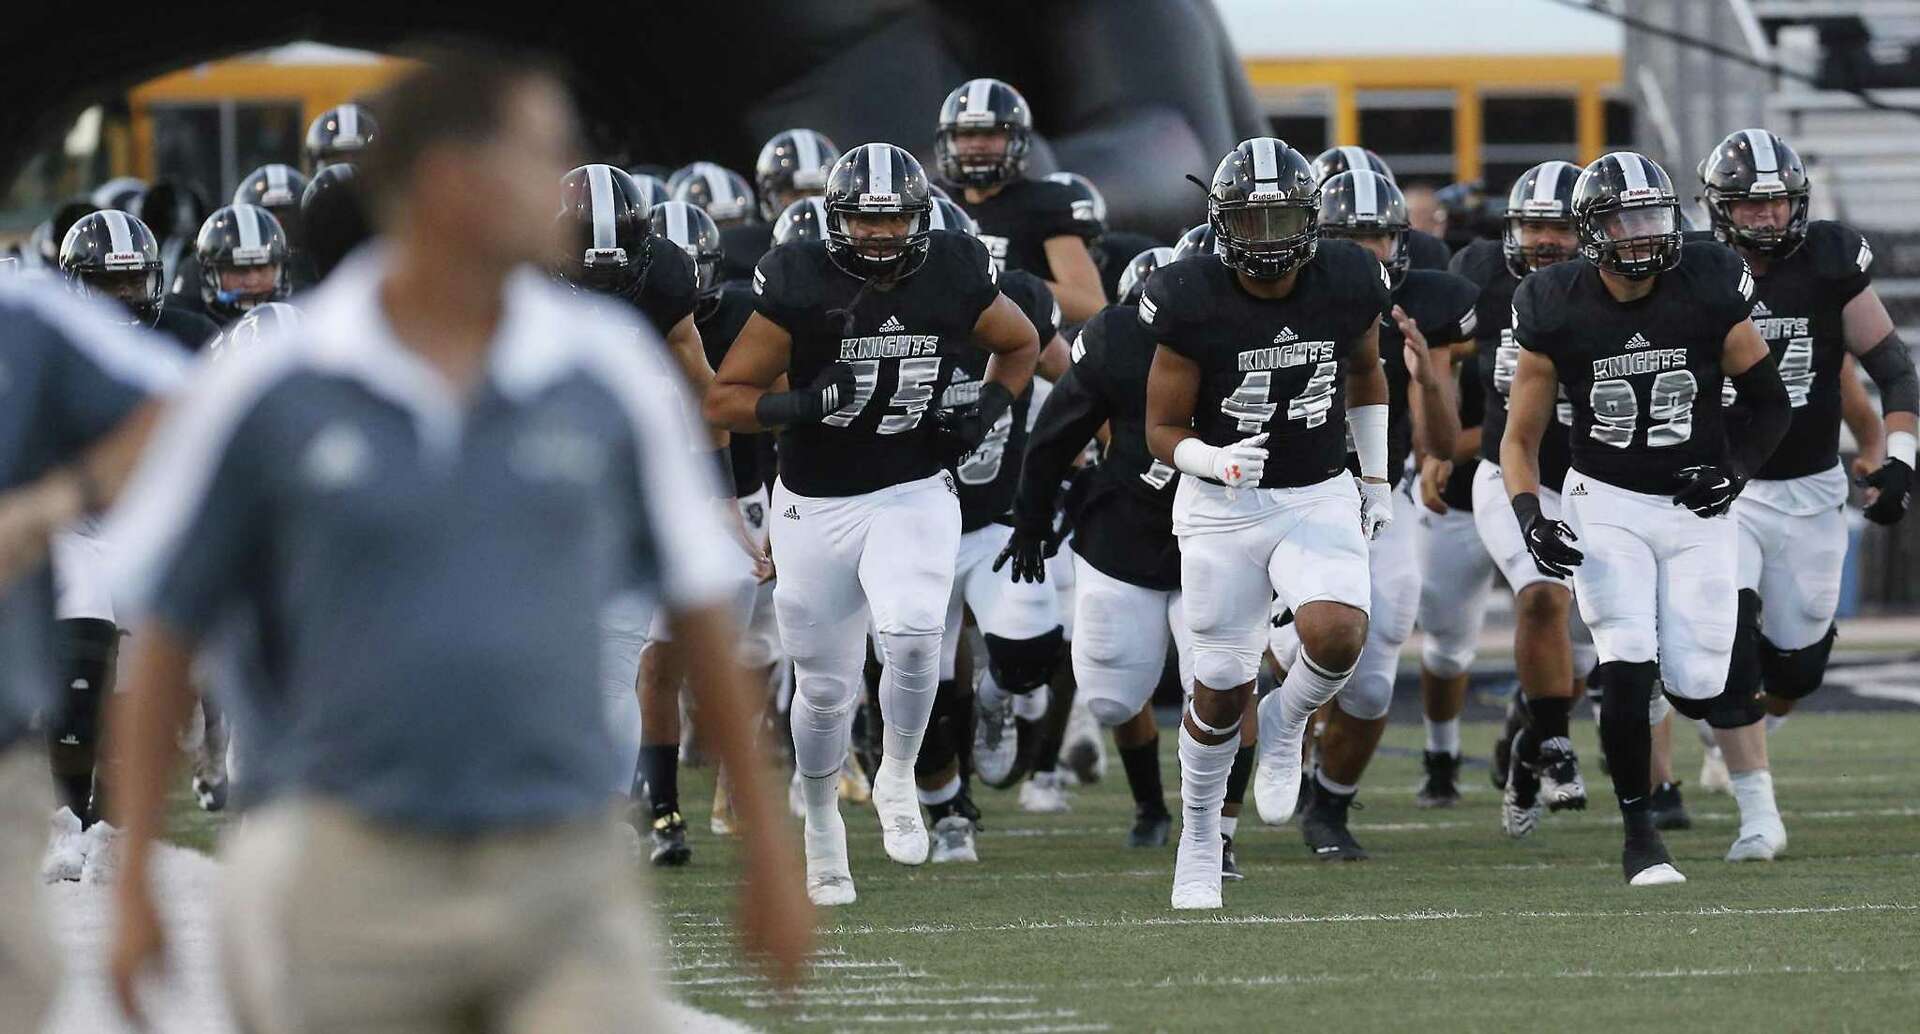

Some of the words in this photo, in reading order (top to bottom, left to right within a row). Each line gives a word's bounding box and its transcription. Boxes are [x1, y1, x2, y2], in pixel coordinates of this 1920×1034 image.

[1252, 192, 1282, 200] Riddell
[839, 335, 939, 359] KNIGHTS
[1238, 341, 1336, 372] KNIGHTS
[1592, 348, 1687, 380] KNIGHTS
[821, 356, 943, 435] 75
[1220, 361, 1338, 434] 44
[1589, 369, 1699, 449] 99
